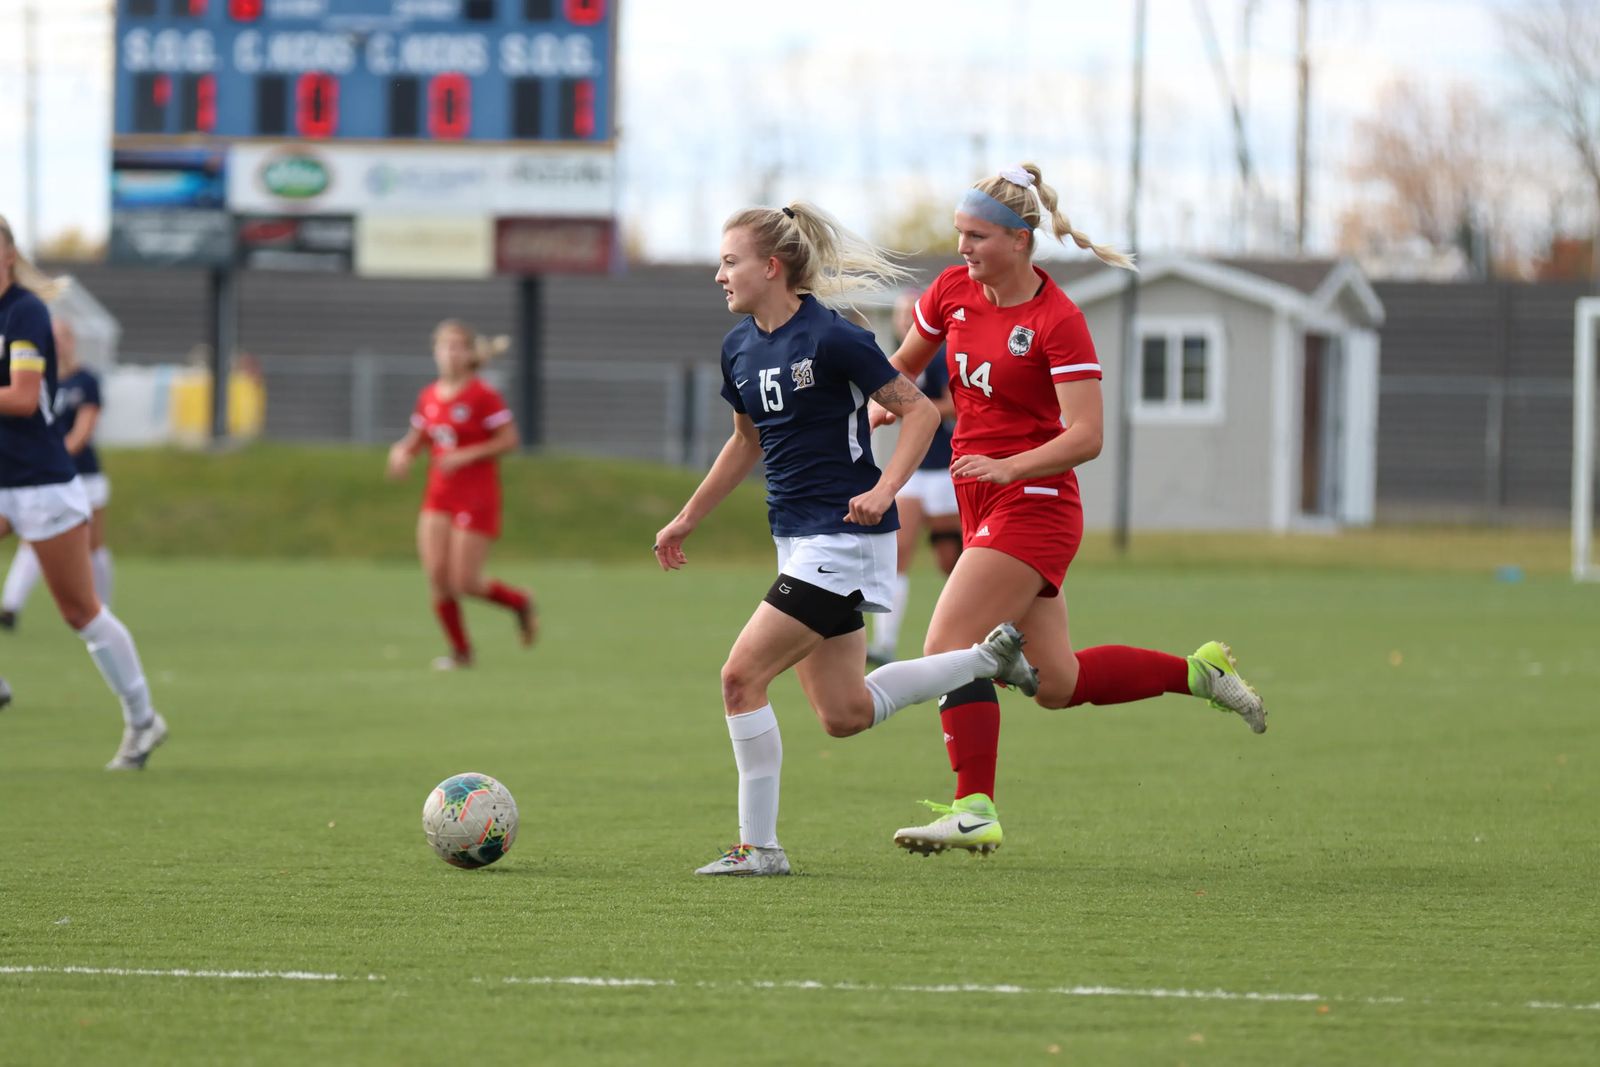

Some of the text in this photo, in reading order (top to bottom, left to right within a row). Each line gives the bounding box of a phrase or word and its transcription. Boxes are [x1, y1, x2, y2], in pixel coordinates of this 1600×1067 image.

[296, 71, 339, 137] 0
[428, 72, 471, 138] 0
[758, 367, 784, 412] 15
[954, 352, 993, 398] 14
